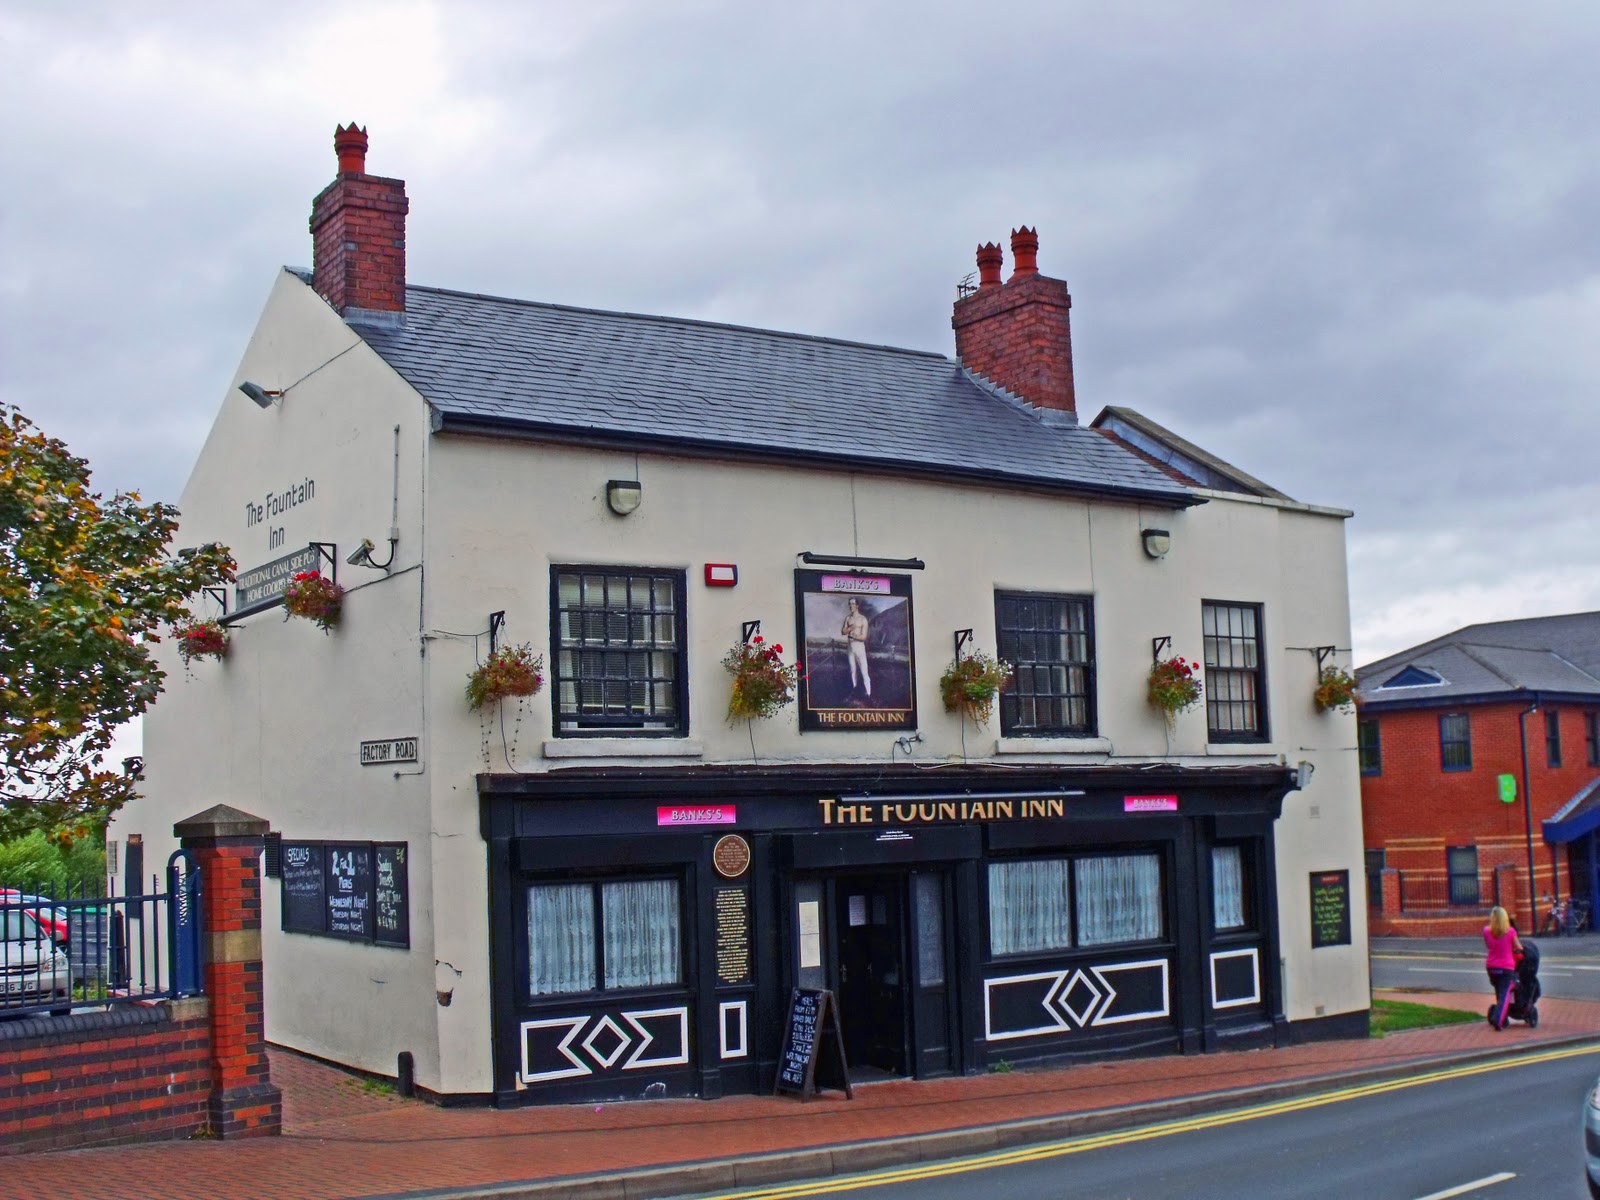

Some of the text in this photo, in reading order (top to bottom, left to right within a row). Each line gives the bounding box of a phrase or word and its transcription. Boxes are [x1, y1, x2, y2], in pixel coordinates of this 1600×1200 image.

[246, 477, 315, 528] The Fountain
[269, 526, 285, 550] Inn
[239, 568, 271, 590] TRADITIONAL
[271, 560, 290, 578] CANAL
[290, 555, 303, 570] SIDE
[834, 578, 880, 591] BANKS'S
[247, 587, 263, 604] HOME
[817, 711, 905, 723] THE FOUNTAIN INN
[363, 741, 415, 761] FACTORY ROAD
[671, 808, 723, 821] BANKS'S
[818, 799, 1064, 824] THE FOUNTAIN INN
